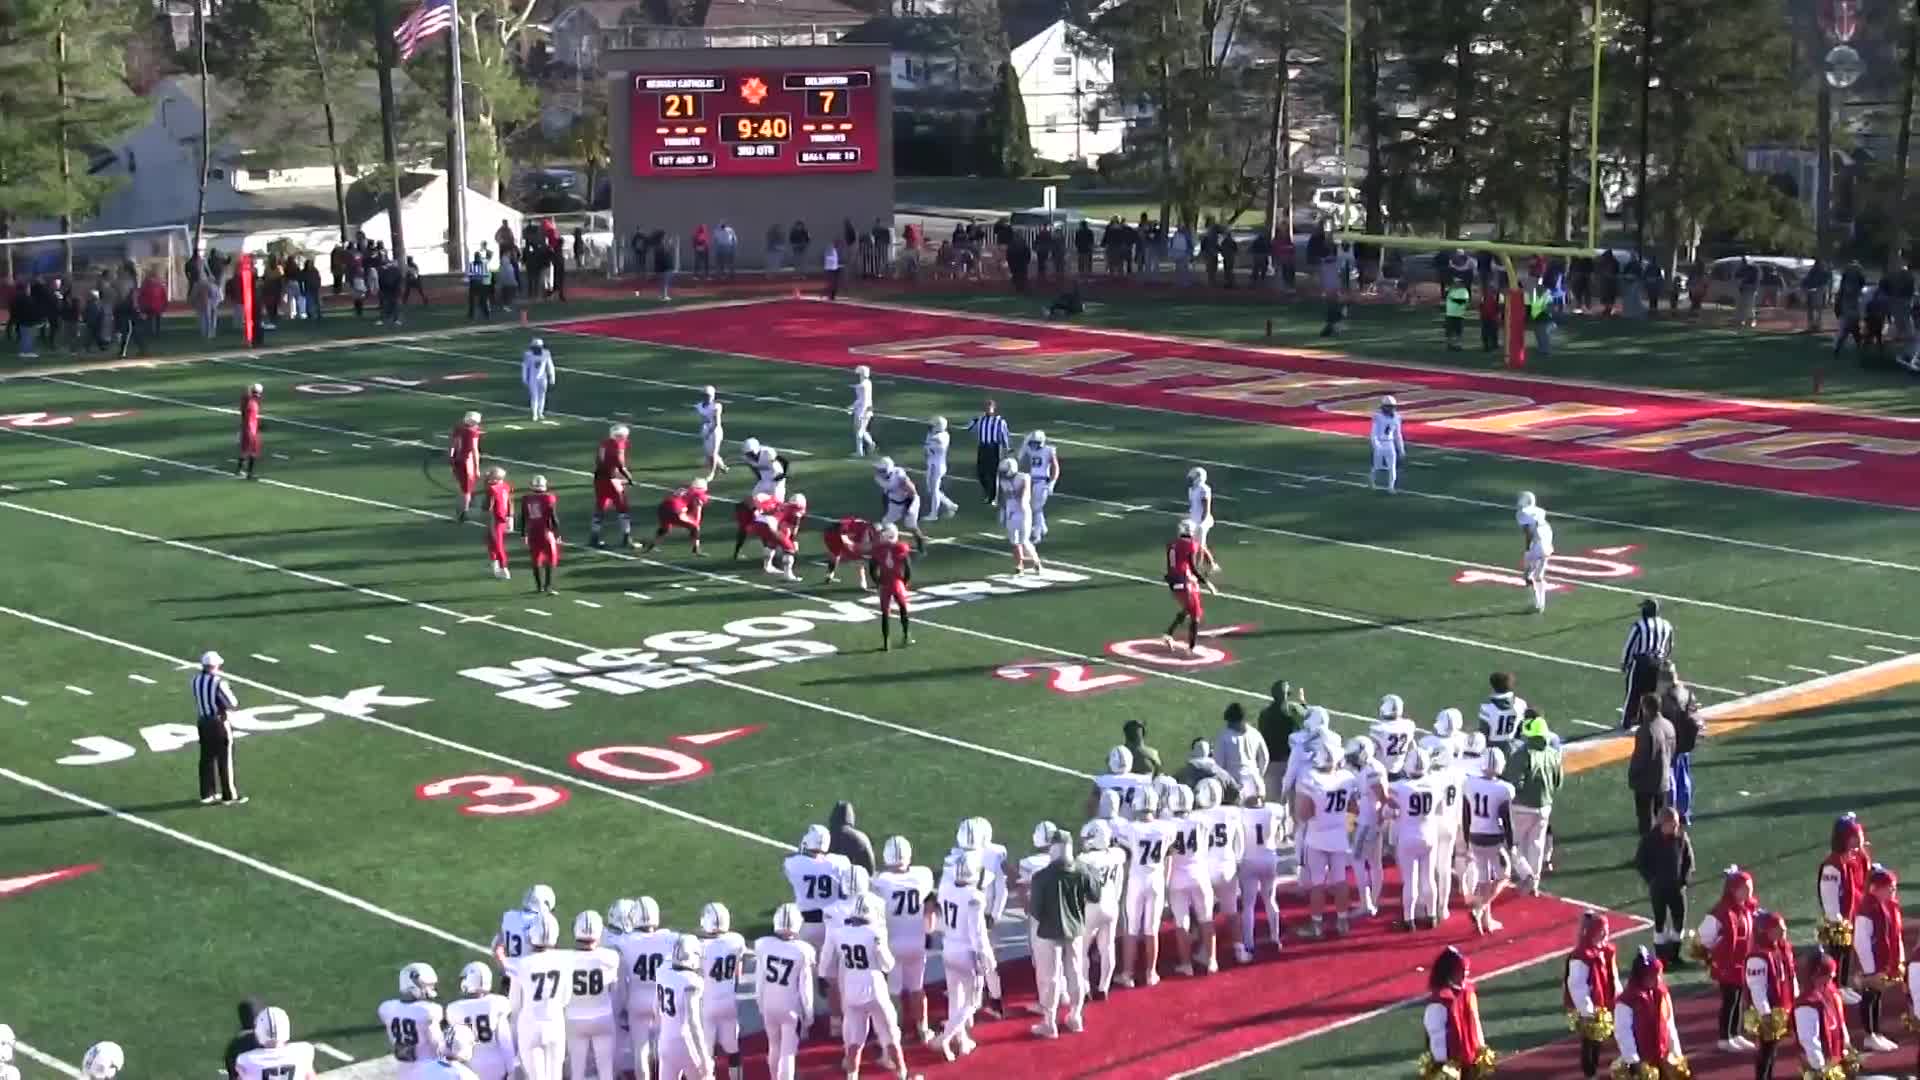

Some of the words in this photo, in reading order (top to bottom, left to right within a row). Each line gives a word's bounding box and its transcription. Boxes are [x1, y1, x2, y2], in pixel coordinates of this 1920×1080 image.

[664, 94, 694, 117] 21
[818, 91, 835, 113] 7
[737, 118, 787, 139] 9:40
[495, 640, 838, 710] FIELD
[993, 637, 1234, 698] 20
[56, 684, 434, 765] JACK
[1496, 715, 1517, 736] 16
[1386, 733, 1409, 756] 22
[416, 745, 712, 817] 30
[1324, 789, 1348, 813] 76
[1408, 791, 1433, 817] 90
[1473, 791, 1490, 818] 11
[1255, 823, 1265, 846] 1
[1138, 839, 1163, 866] 74
[802, 873, 833, 899] 79
[891, 888, 921, 916] 70
[943, 899, 959, 929] 17
[840, 943, 870, 970] 39
[571, 968, 604, 997] 58
[765, 955, 794, 987] 57
[530, 969, 561, 1002] 77
